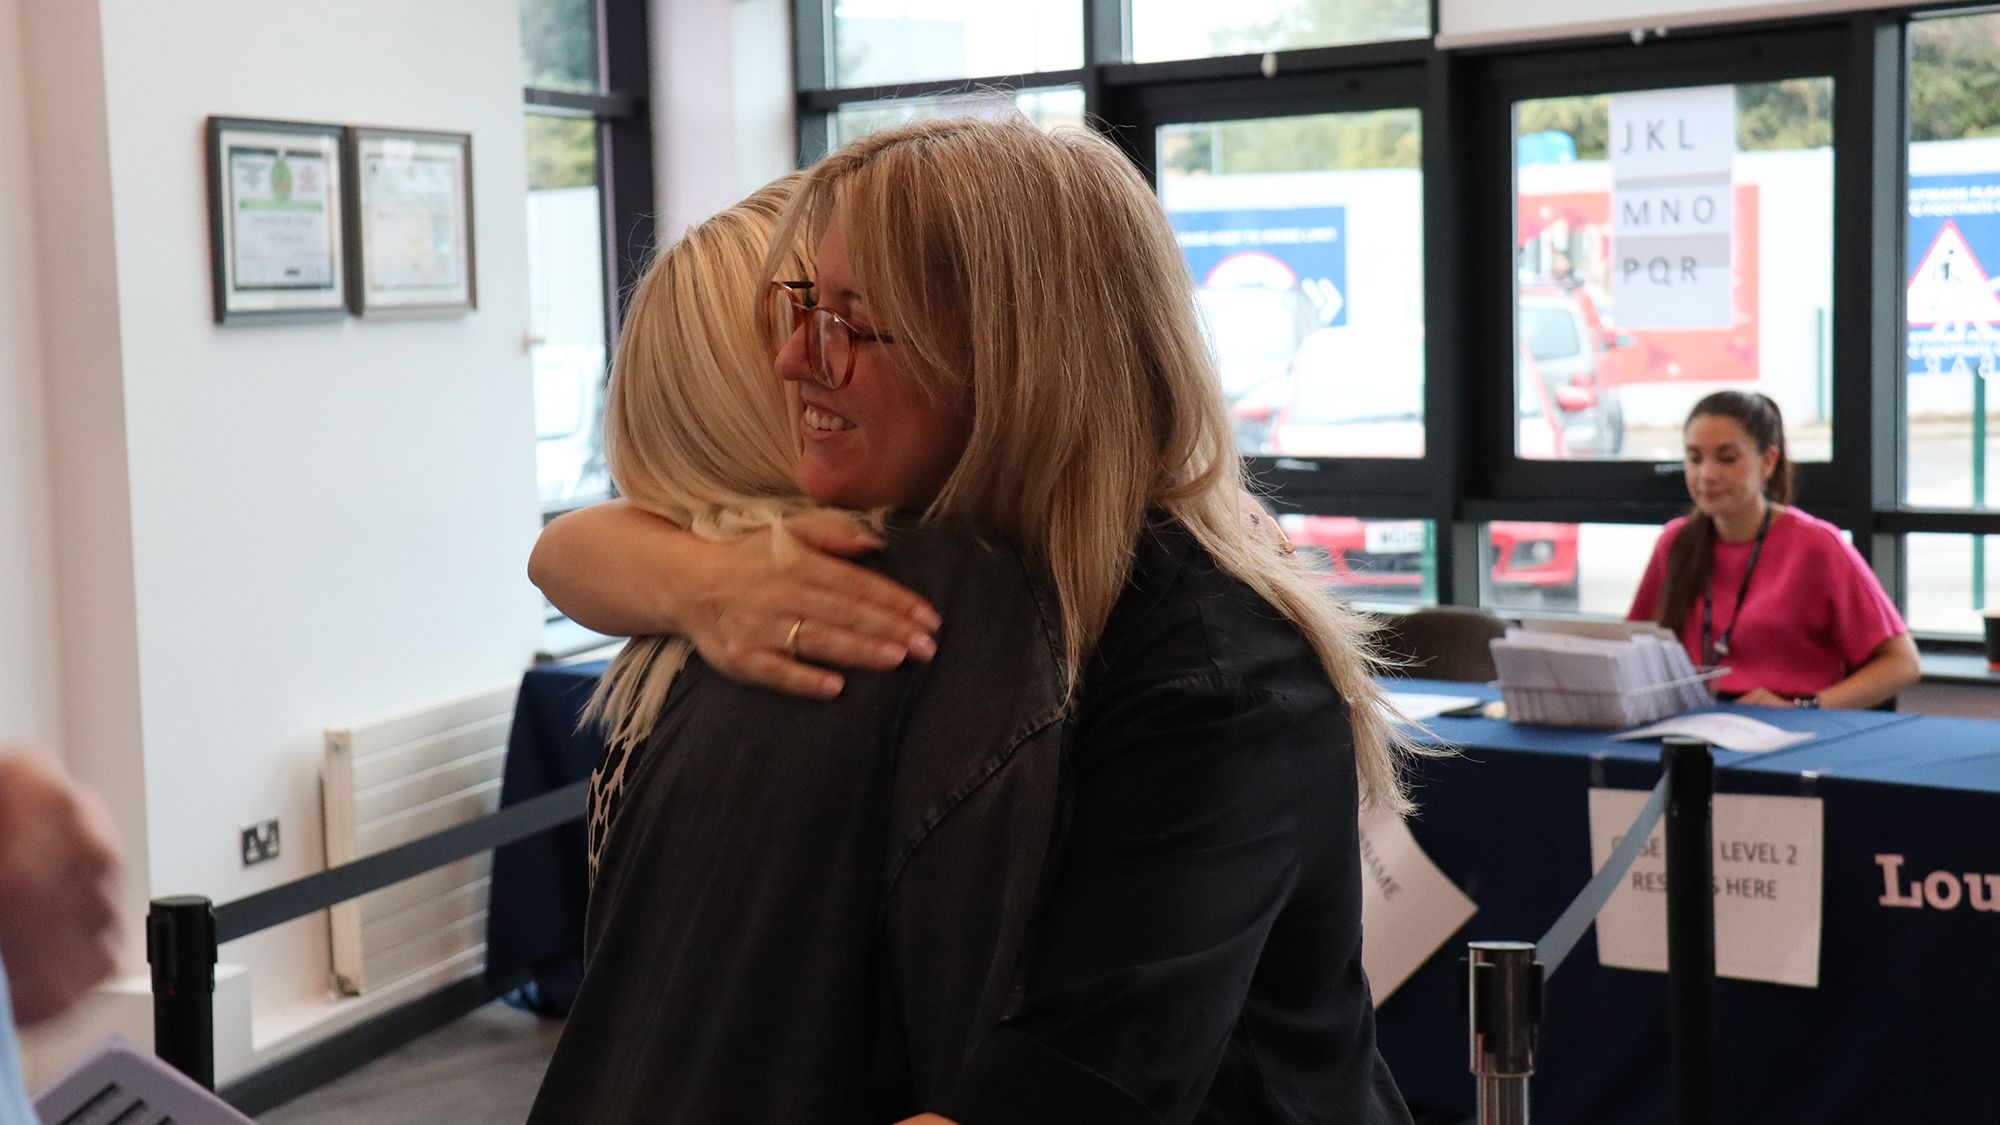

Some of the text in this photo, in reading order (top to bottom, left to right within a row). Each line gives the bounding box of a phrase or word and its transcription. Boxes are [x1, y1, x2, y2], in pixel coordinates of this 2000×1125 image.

[1720, 841, 1780, 865] LEVEL
[1785, 844, 1798, 866] 2
[1725, 877, 1778, 901] HERE
